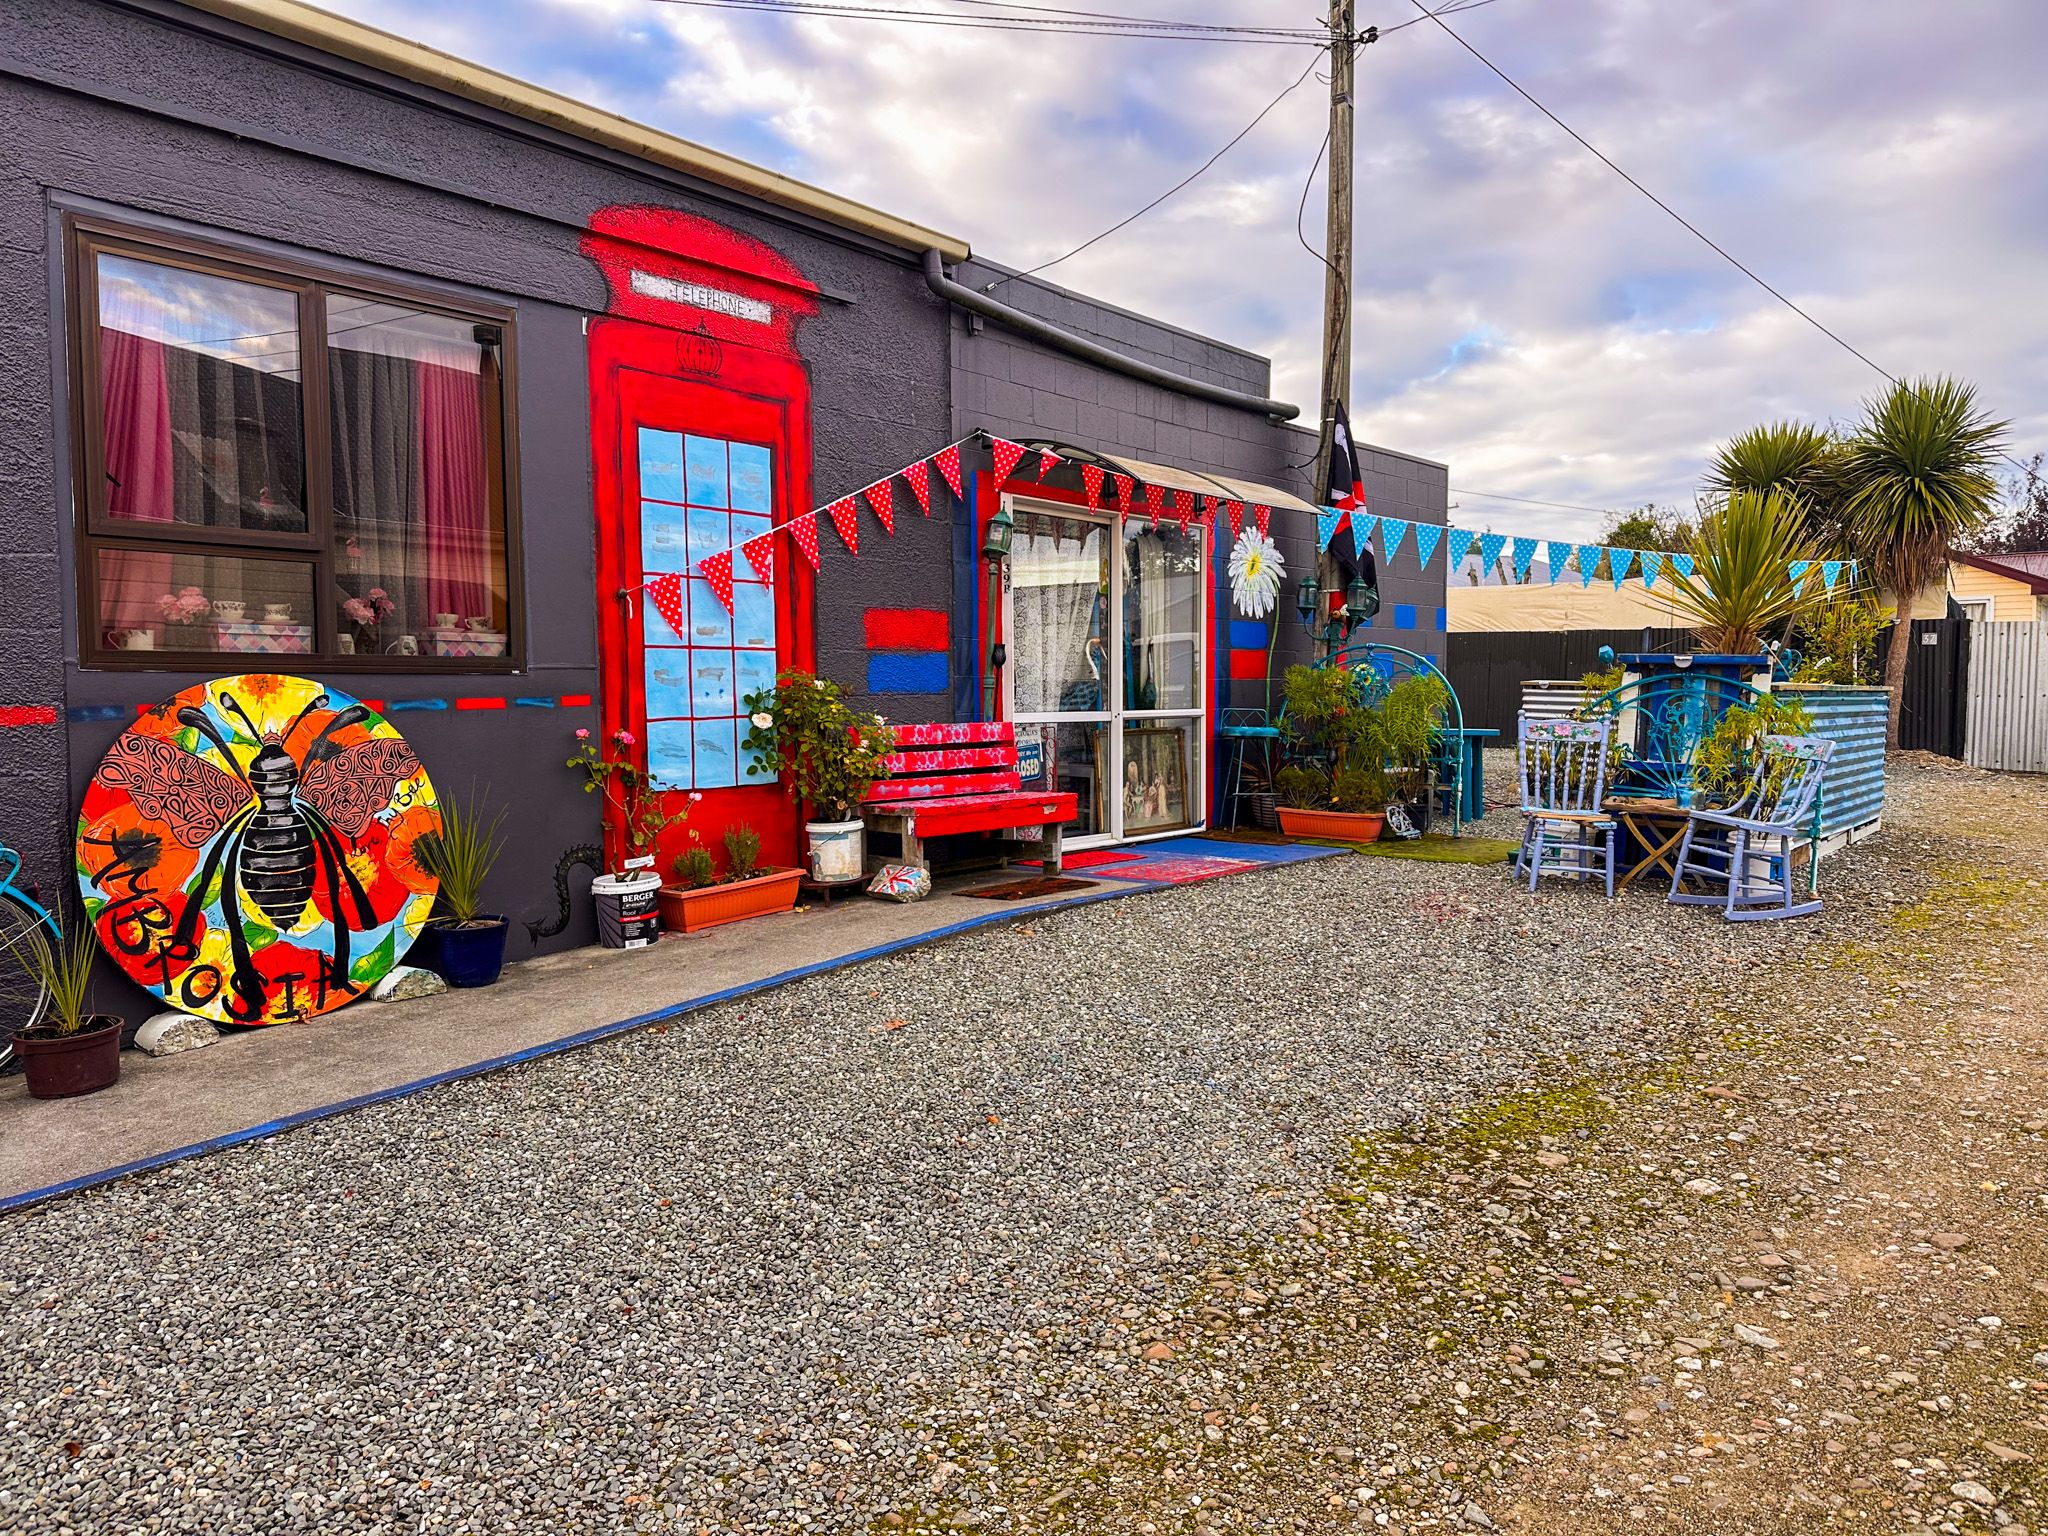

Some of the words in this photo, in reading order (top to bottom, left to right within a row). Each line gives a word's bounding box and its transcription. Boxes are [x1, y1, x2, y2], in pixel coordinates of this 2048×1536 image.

[671, 282, 745, 316] TELEPHONE
[394, 777, 426, 807] Bee
[622, 891, 654, 903] BERGER
